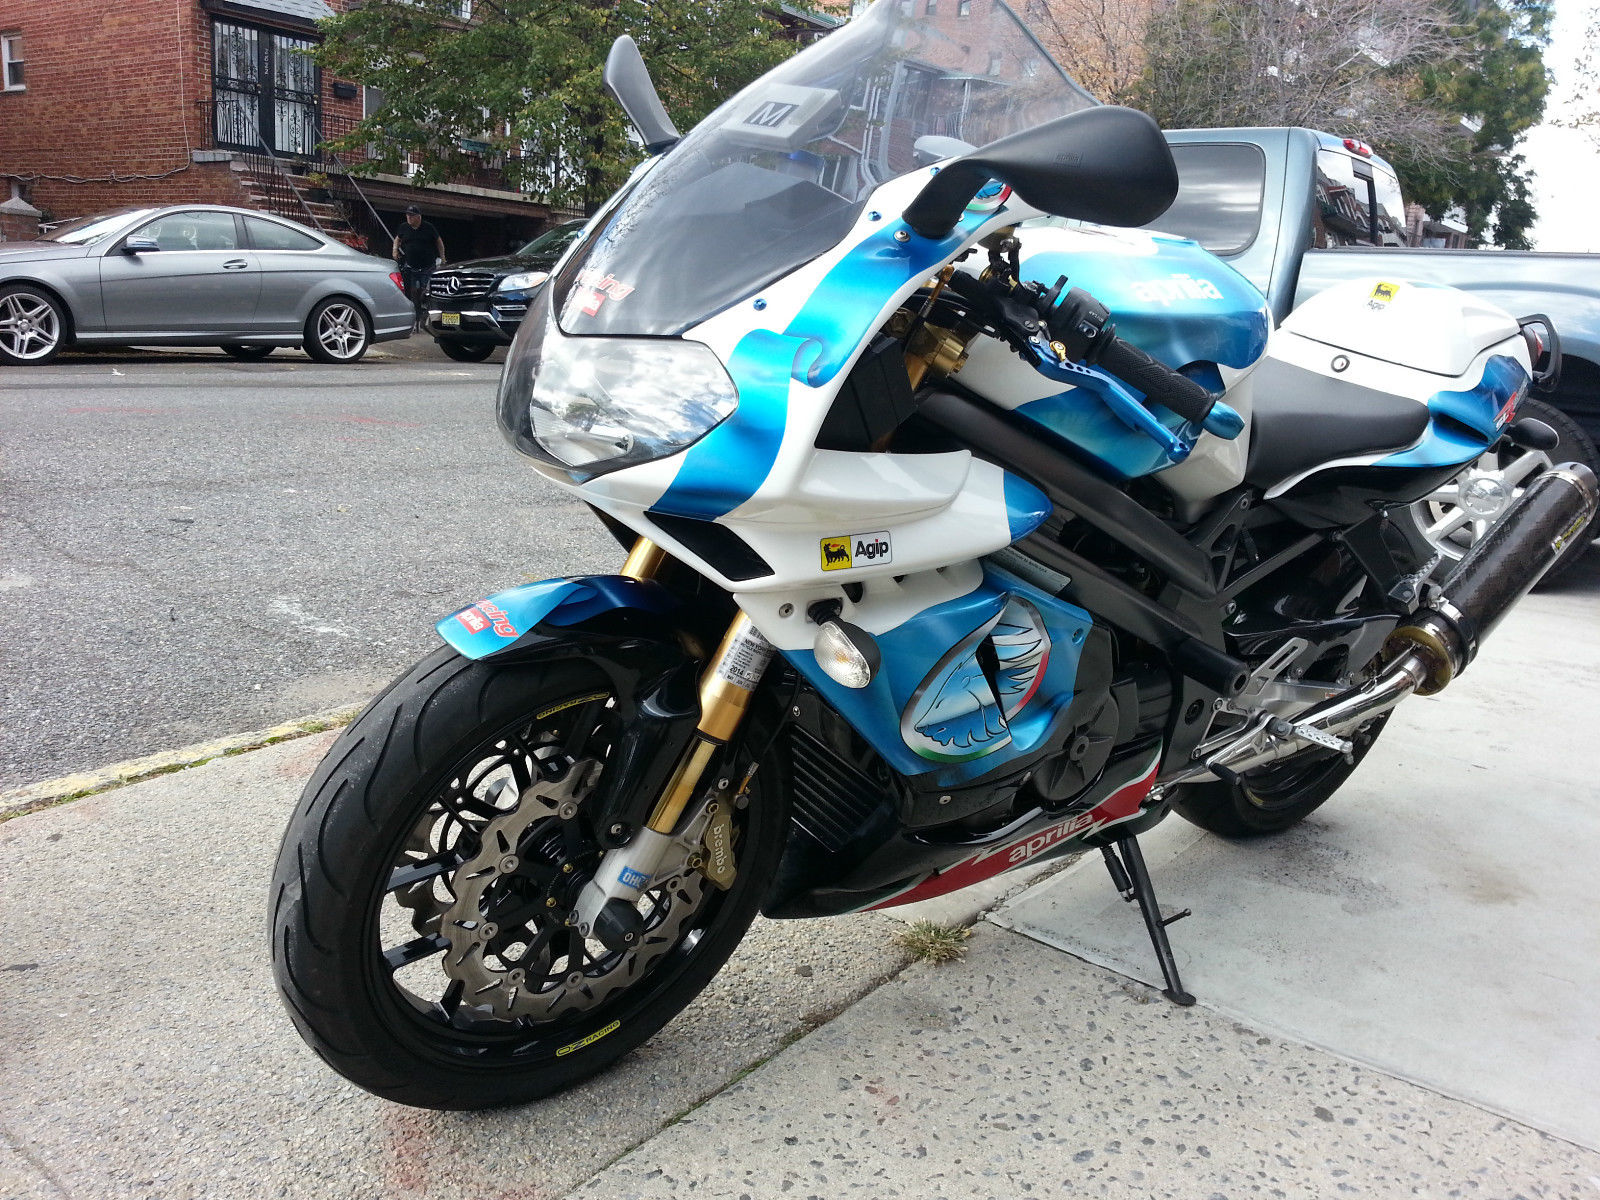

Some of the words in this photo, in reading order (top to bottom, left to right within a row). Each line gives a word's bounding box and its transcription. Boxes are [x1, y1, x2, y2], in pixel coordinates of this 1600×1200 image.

[750, 102, 793, 126] M
[1129, 273, 1224, 306] aprilia
[855, 539, 889, 559] Agip
[730, 665, 744, 675] 2014
[713, 823, 727, 874] brembo
[1009, 814, 1093, 862] aprilia
[585, 1021, 619, 1042] RACING
